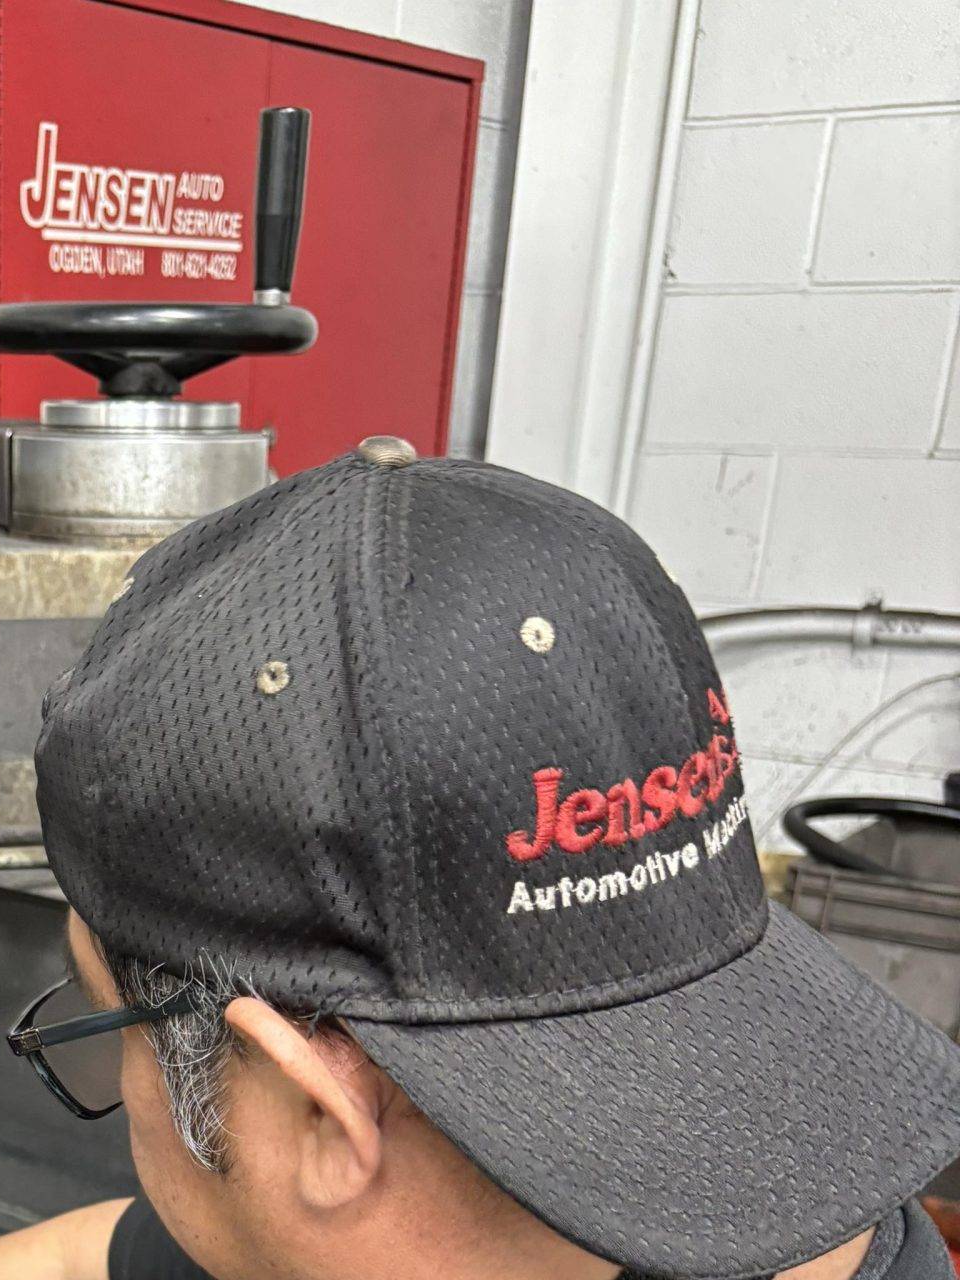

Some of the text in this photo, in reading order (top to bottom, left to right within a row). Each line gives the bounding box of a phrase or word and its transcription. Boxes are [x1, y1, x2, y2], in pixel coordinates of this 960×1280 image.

[19, 120, 176, 234] JENSEN
[176, 172, 224, 201] AUTO
[172, 207, 243, 238] SERVICE
[48, 244, 106, 279] OGDEN,
[106, 249, 144, 276] UTAH
[507, 843, 700, 914] Automotive
